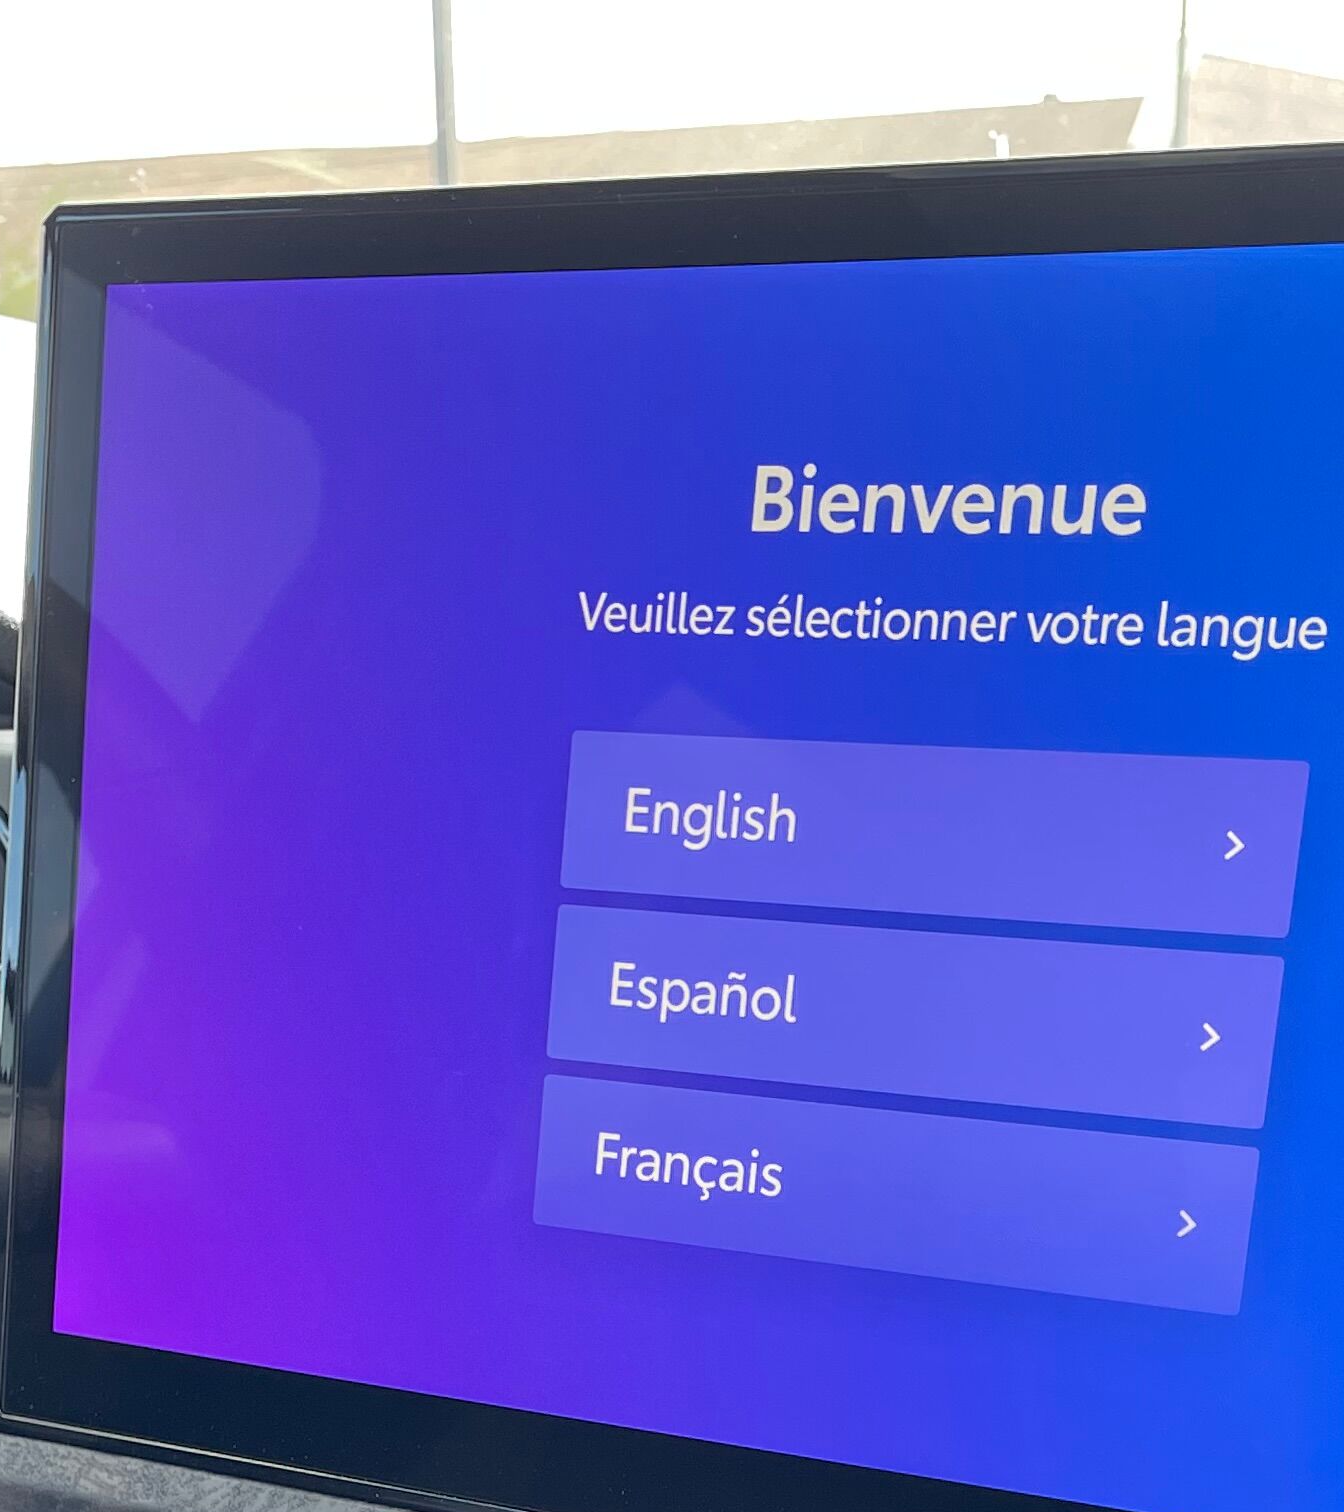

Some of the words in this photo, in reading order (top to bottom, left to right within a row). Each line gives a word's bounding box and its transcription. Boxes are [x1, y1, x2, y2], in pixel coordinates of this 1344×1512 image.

[749, 463, 1148, 536] Bienvenue
[577, 590, 736, 637] Veuillez
[744, 593, 1019, 645] sélectionner
[1024, 603, 1145, 647] votre
[1157, 600, 1328, 662] langue
[623, 786, 797, 851] English
[608, 960, 797, 1024] Español
[593, 1131, 784, 1201] Français
